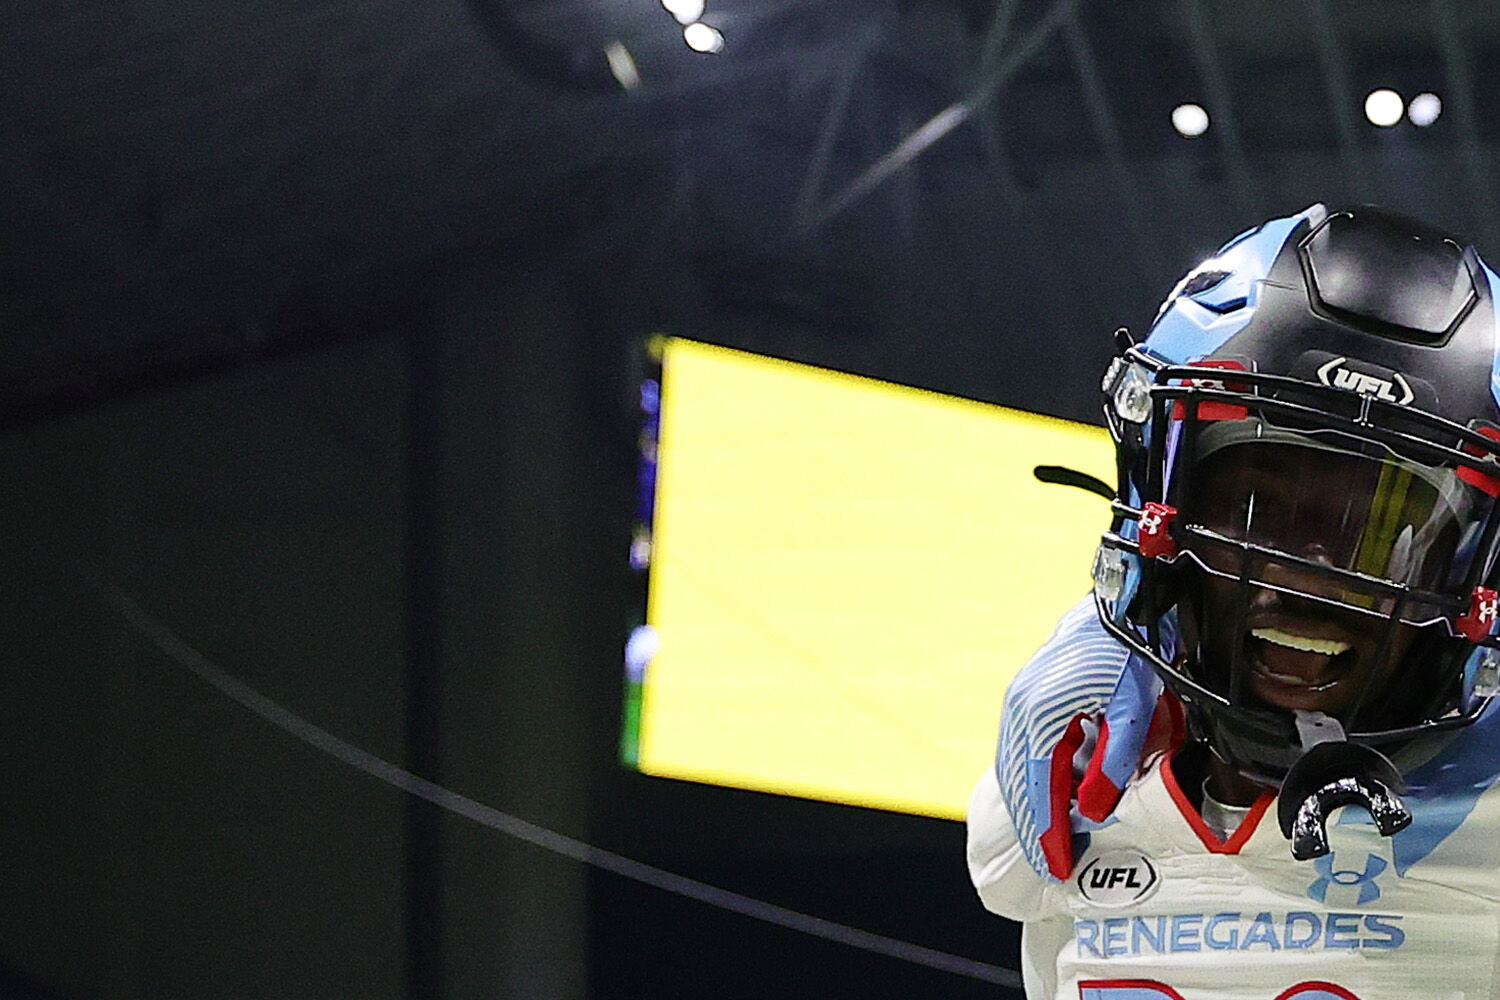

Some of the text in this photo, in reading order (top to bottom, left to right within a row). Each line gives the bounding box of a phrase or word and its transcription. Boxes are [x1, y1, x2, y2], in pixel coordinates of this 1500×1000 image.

[1333, 367, 1397, 403] UFL
[1089, 867, 1142, 890] UFL
[1073, 910, 1406, 958] RENEGADES
